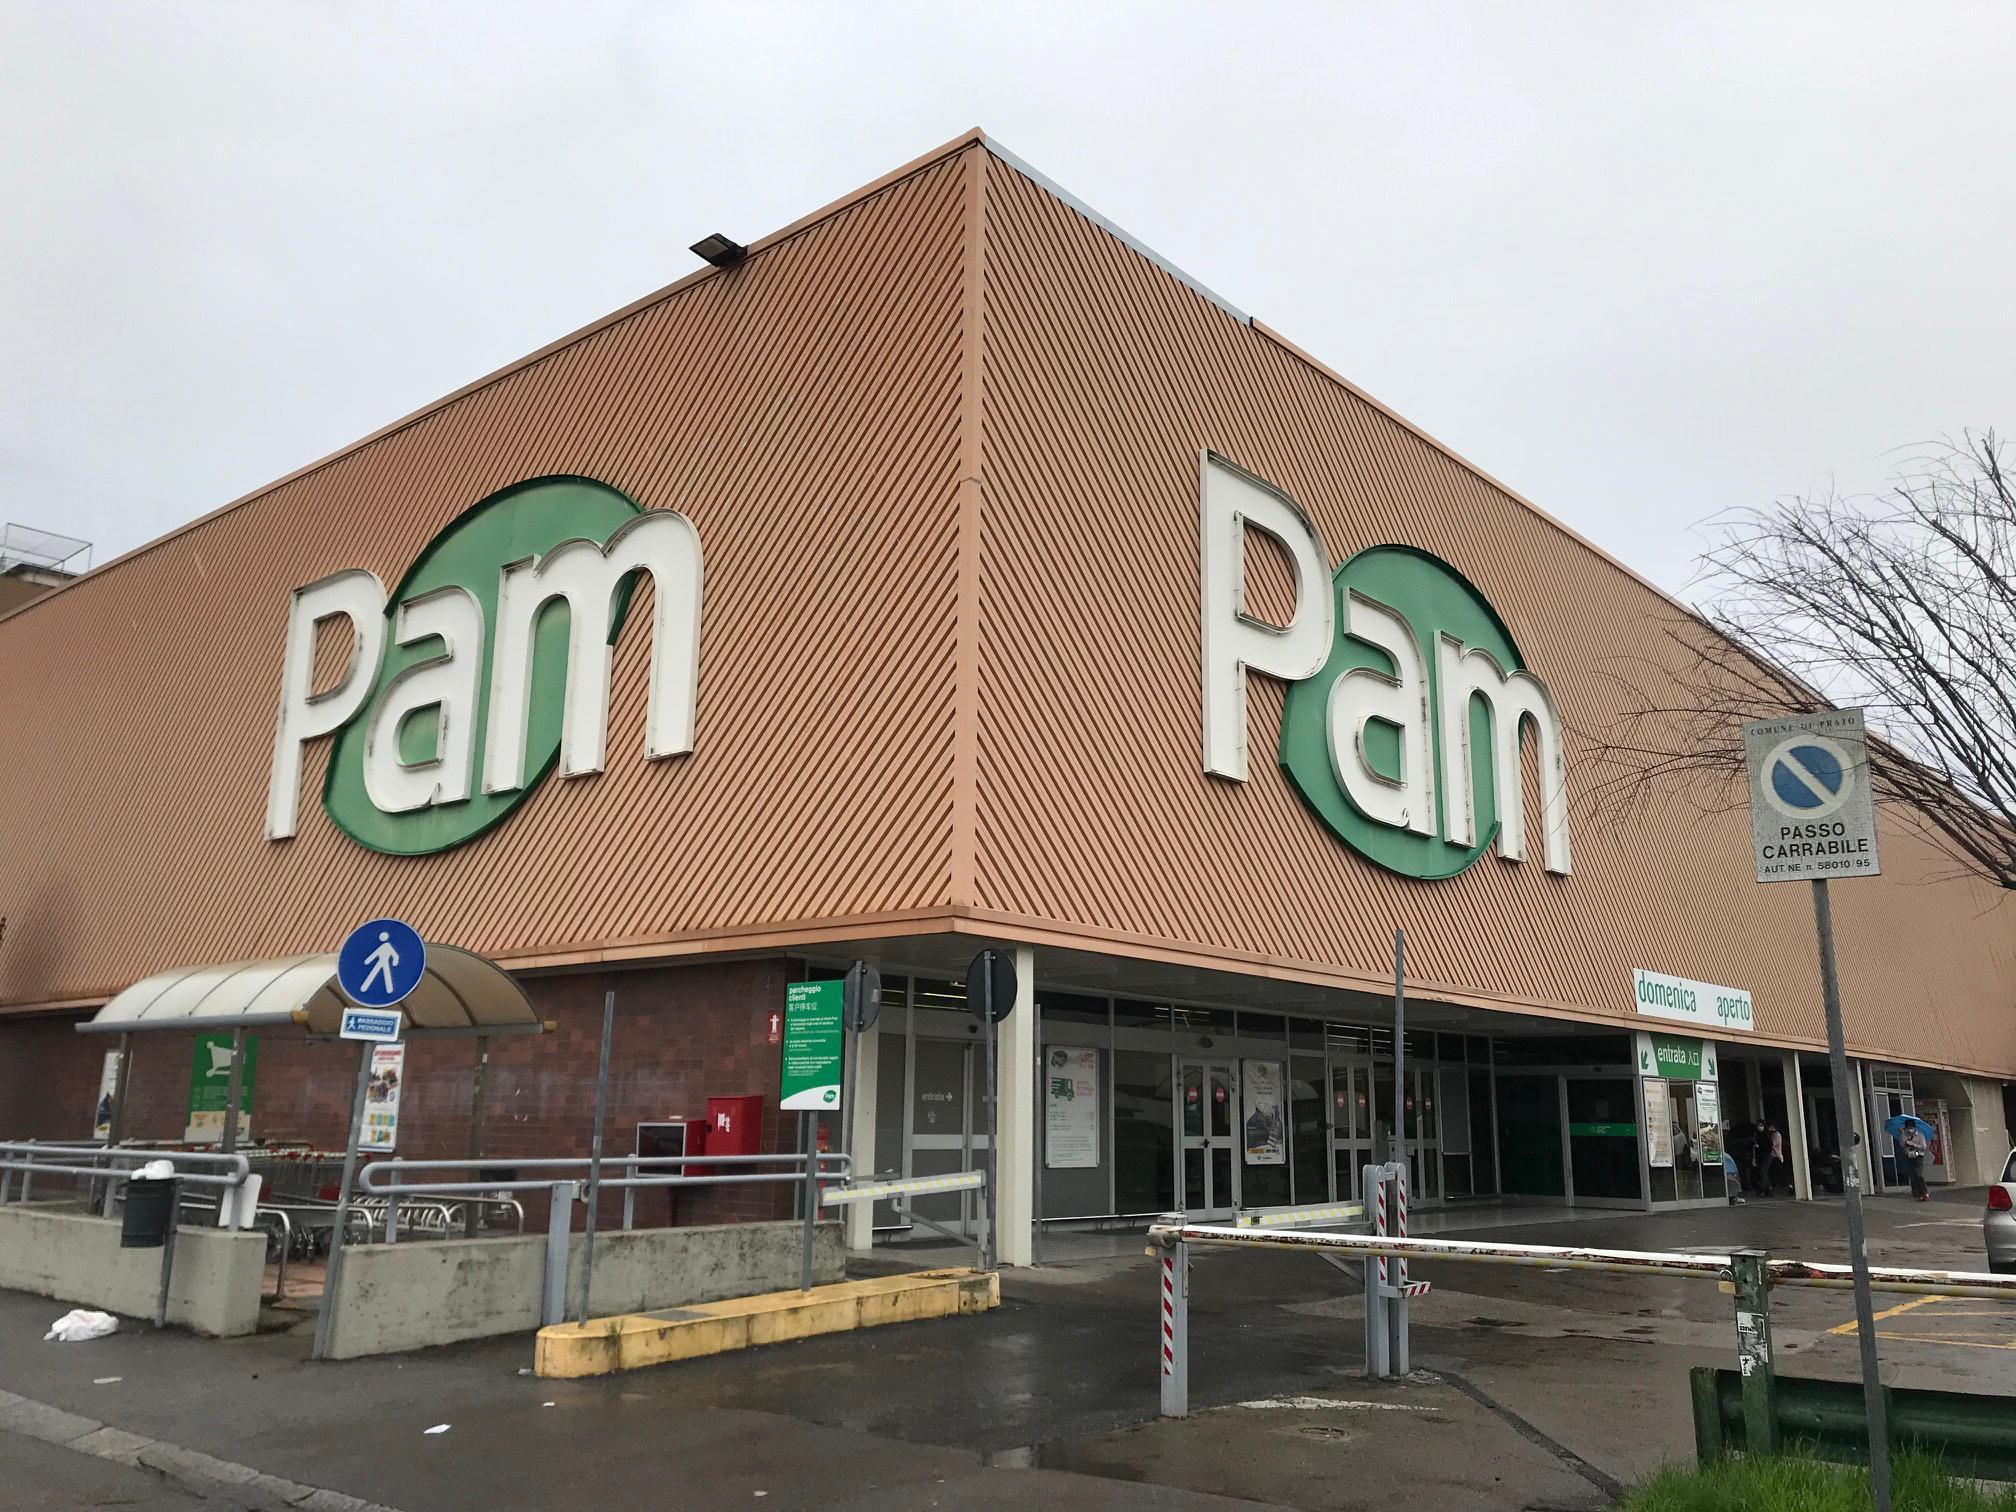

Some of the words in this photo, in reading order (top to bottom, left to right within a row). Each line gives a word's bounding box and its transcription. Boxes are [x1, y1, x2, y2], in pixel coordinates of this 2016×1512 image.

[1200, 448, 1572, 877] Pam
[264, 508, 704, 841] Pam
[1750, 725, 1794, 736] COMUNE
[1801, 722, 1812, 731] DI
[1820, 717, 1855, 728] PRATO
[1781, 822, 1846, 840] PASSO
[1763, 838, 1869, 859] CARRABILE
[788, 985, 822, 995] parcheggio
[1638, 971, 1697, 1013] domenica
[1716, 995, 1750, 1026] aperto
[1657, 1043, 1686, 1064] entrata
